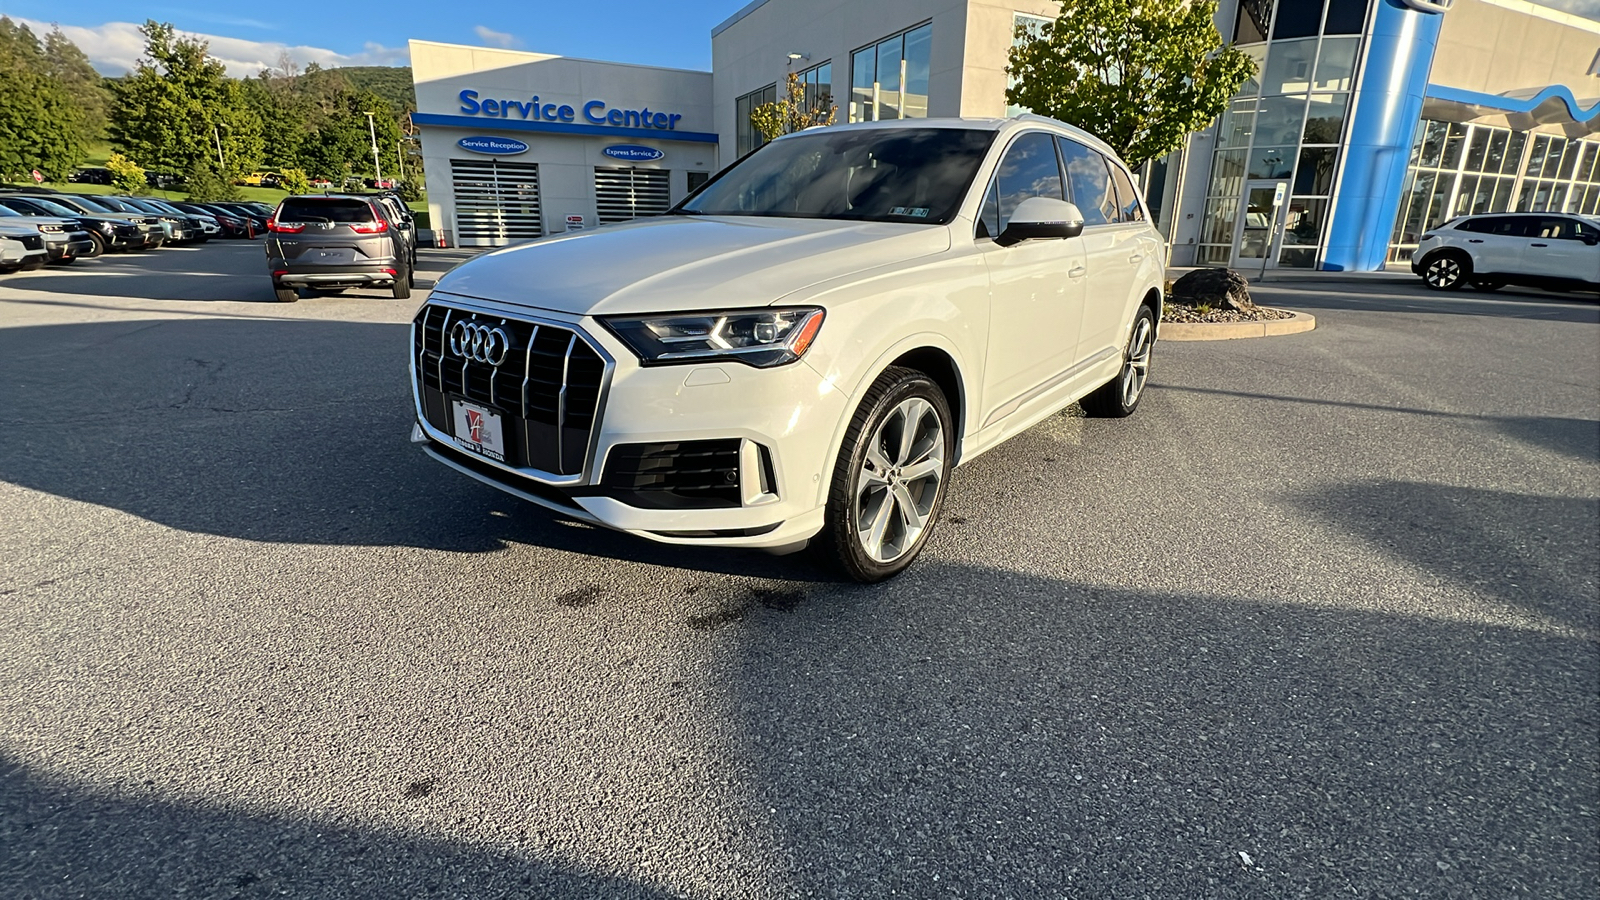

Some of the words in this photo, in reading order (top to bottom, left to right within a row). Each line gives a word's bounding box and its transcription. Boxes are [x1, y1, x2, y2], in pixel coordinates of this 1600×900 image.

[459, 89, 575, 123] Service
[583, 100, 682, 130] Center
[462, 139, 489, 148] Service
[490, 141, 525, 151] Reception
[606, 148, 629, 156] Express
[630, 149, 652, 157] Service
